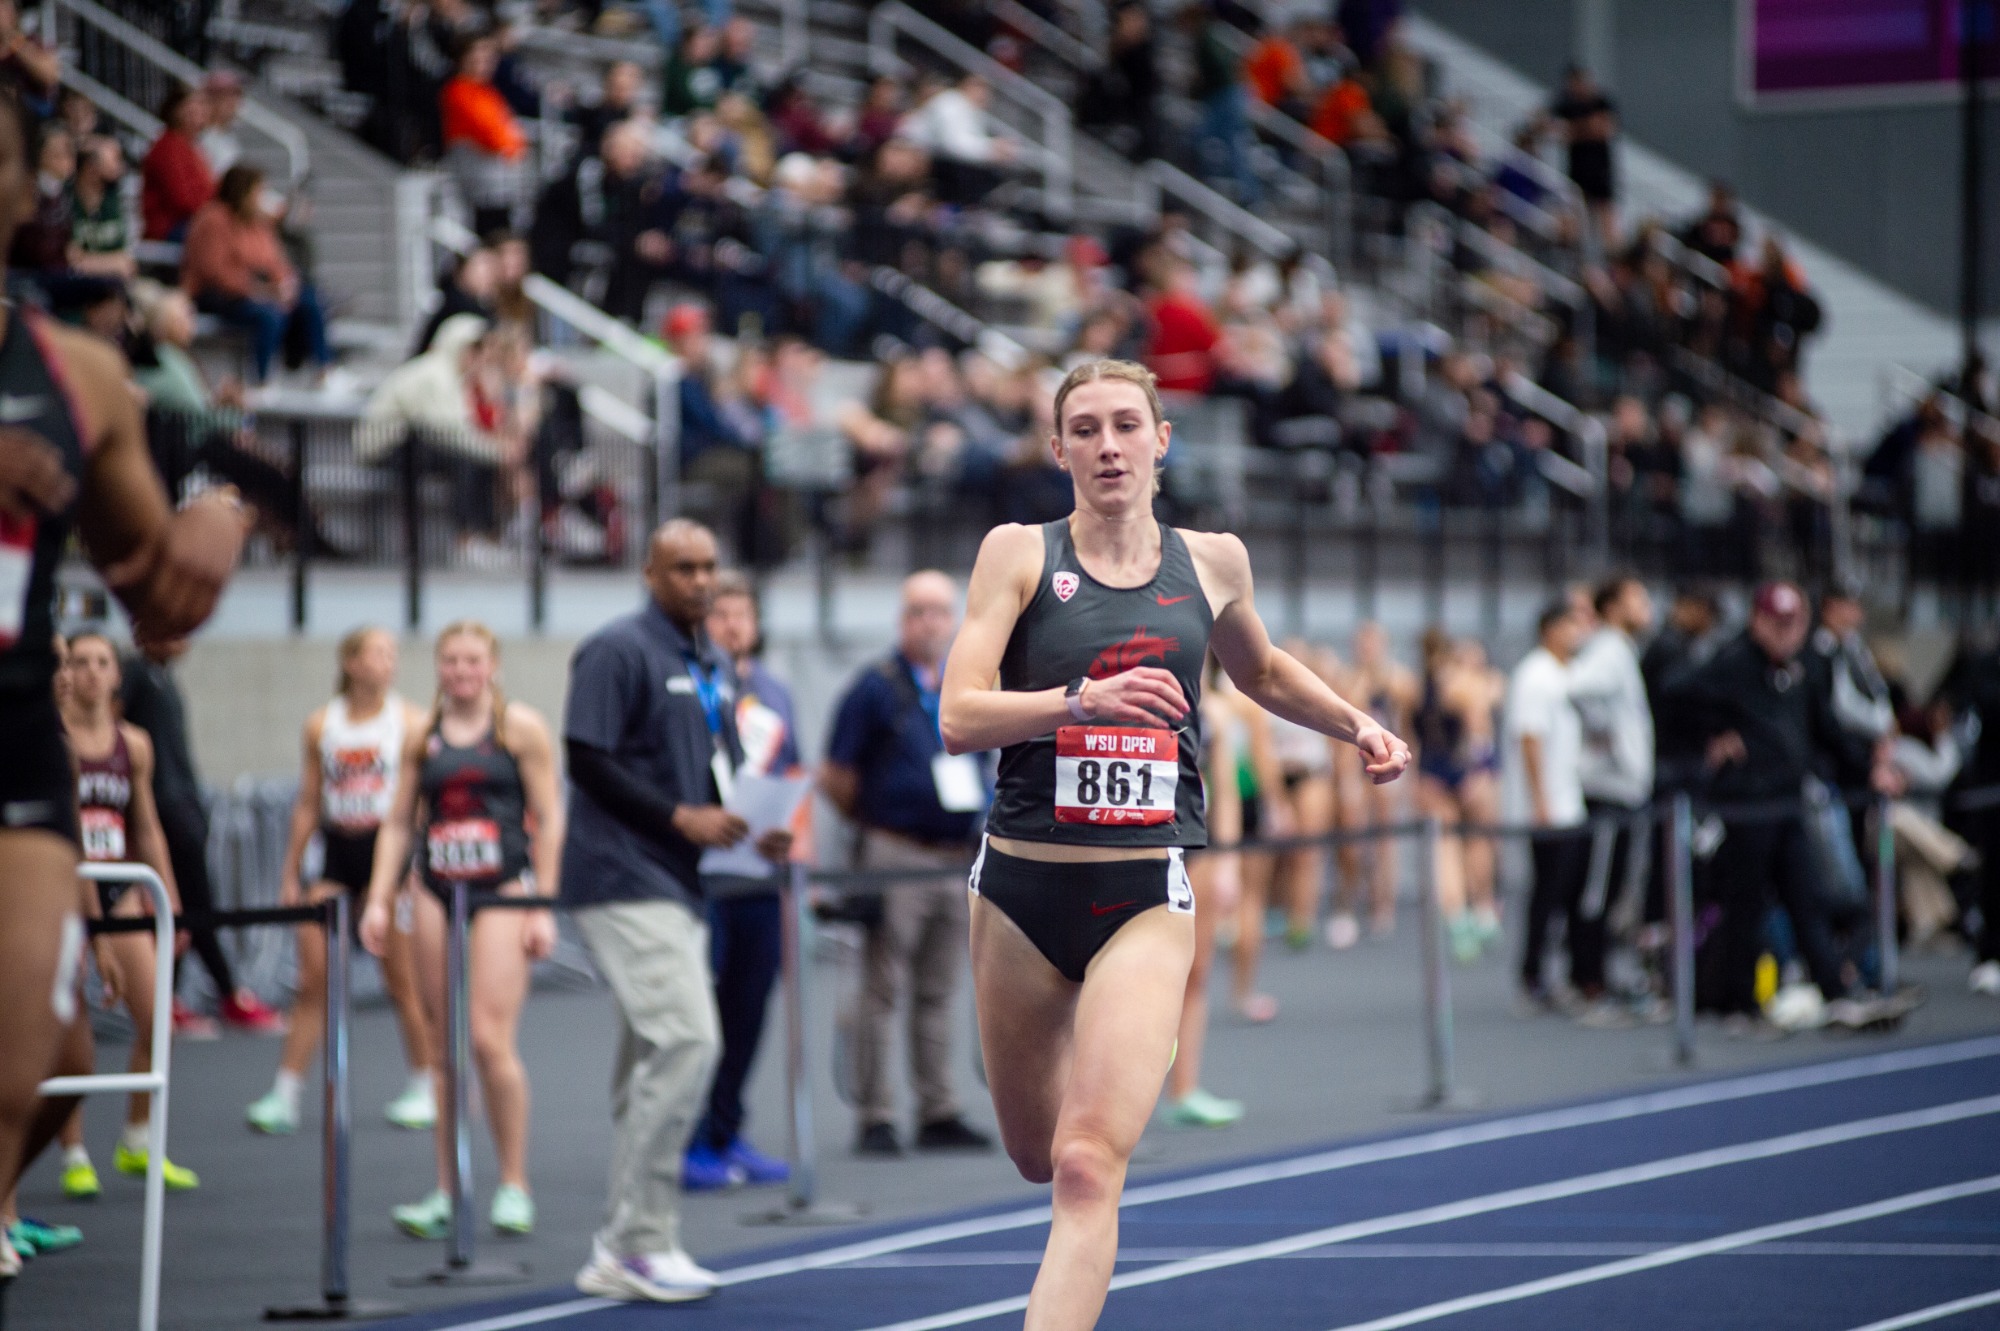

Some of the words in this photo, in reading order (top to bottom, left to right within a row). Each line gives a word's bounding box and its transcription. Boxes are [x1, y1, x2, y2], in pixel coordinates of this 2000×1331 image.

[1058, 584, 1073, 596] 12
[1085, 734, 1118, 751] WSU
[1121, 735, 1156, 754] OPEN
[1077, 759, 1155, 807] 861
